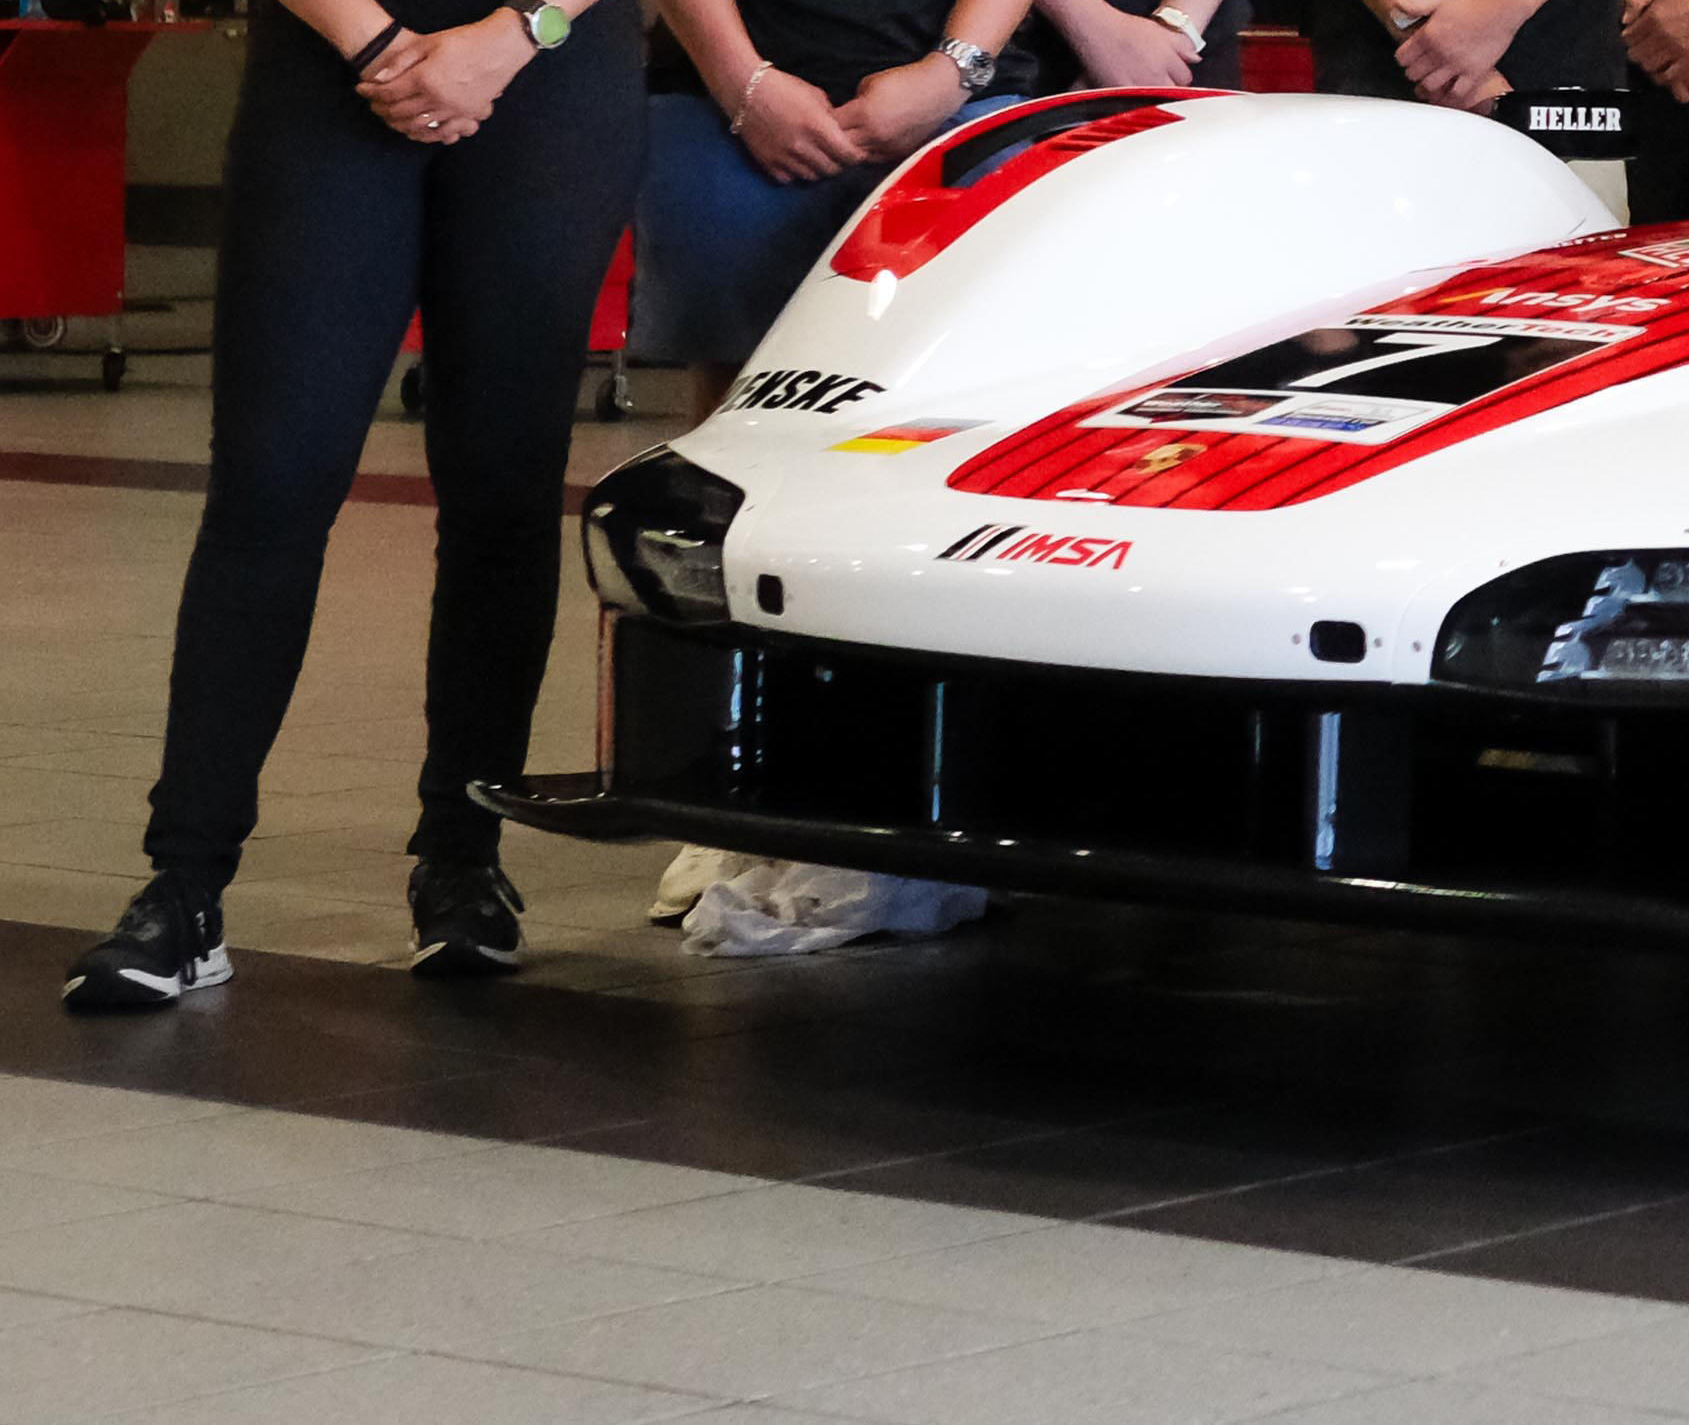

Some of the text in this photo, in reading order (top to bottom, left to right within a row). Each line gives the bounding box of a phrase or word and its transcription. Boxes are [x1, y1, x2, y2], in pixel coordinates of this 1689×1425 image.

[1529, 106, 1622, 132] HELLER
[1344, 317, 1618, 341] WeatherTech
[1289, 332, 1504, 387] 7
[712, 370, 888, 415] ENSKE
